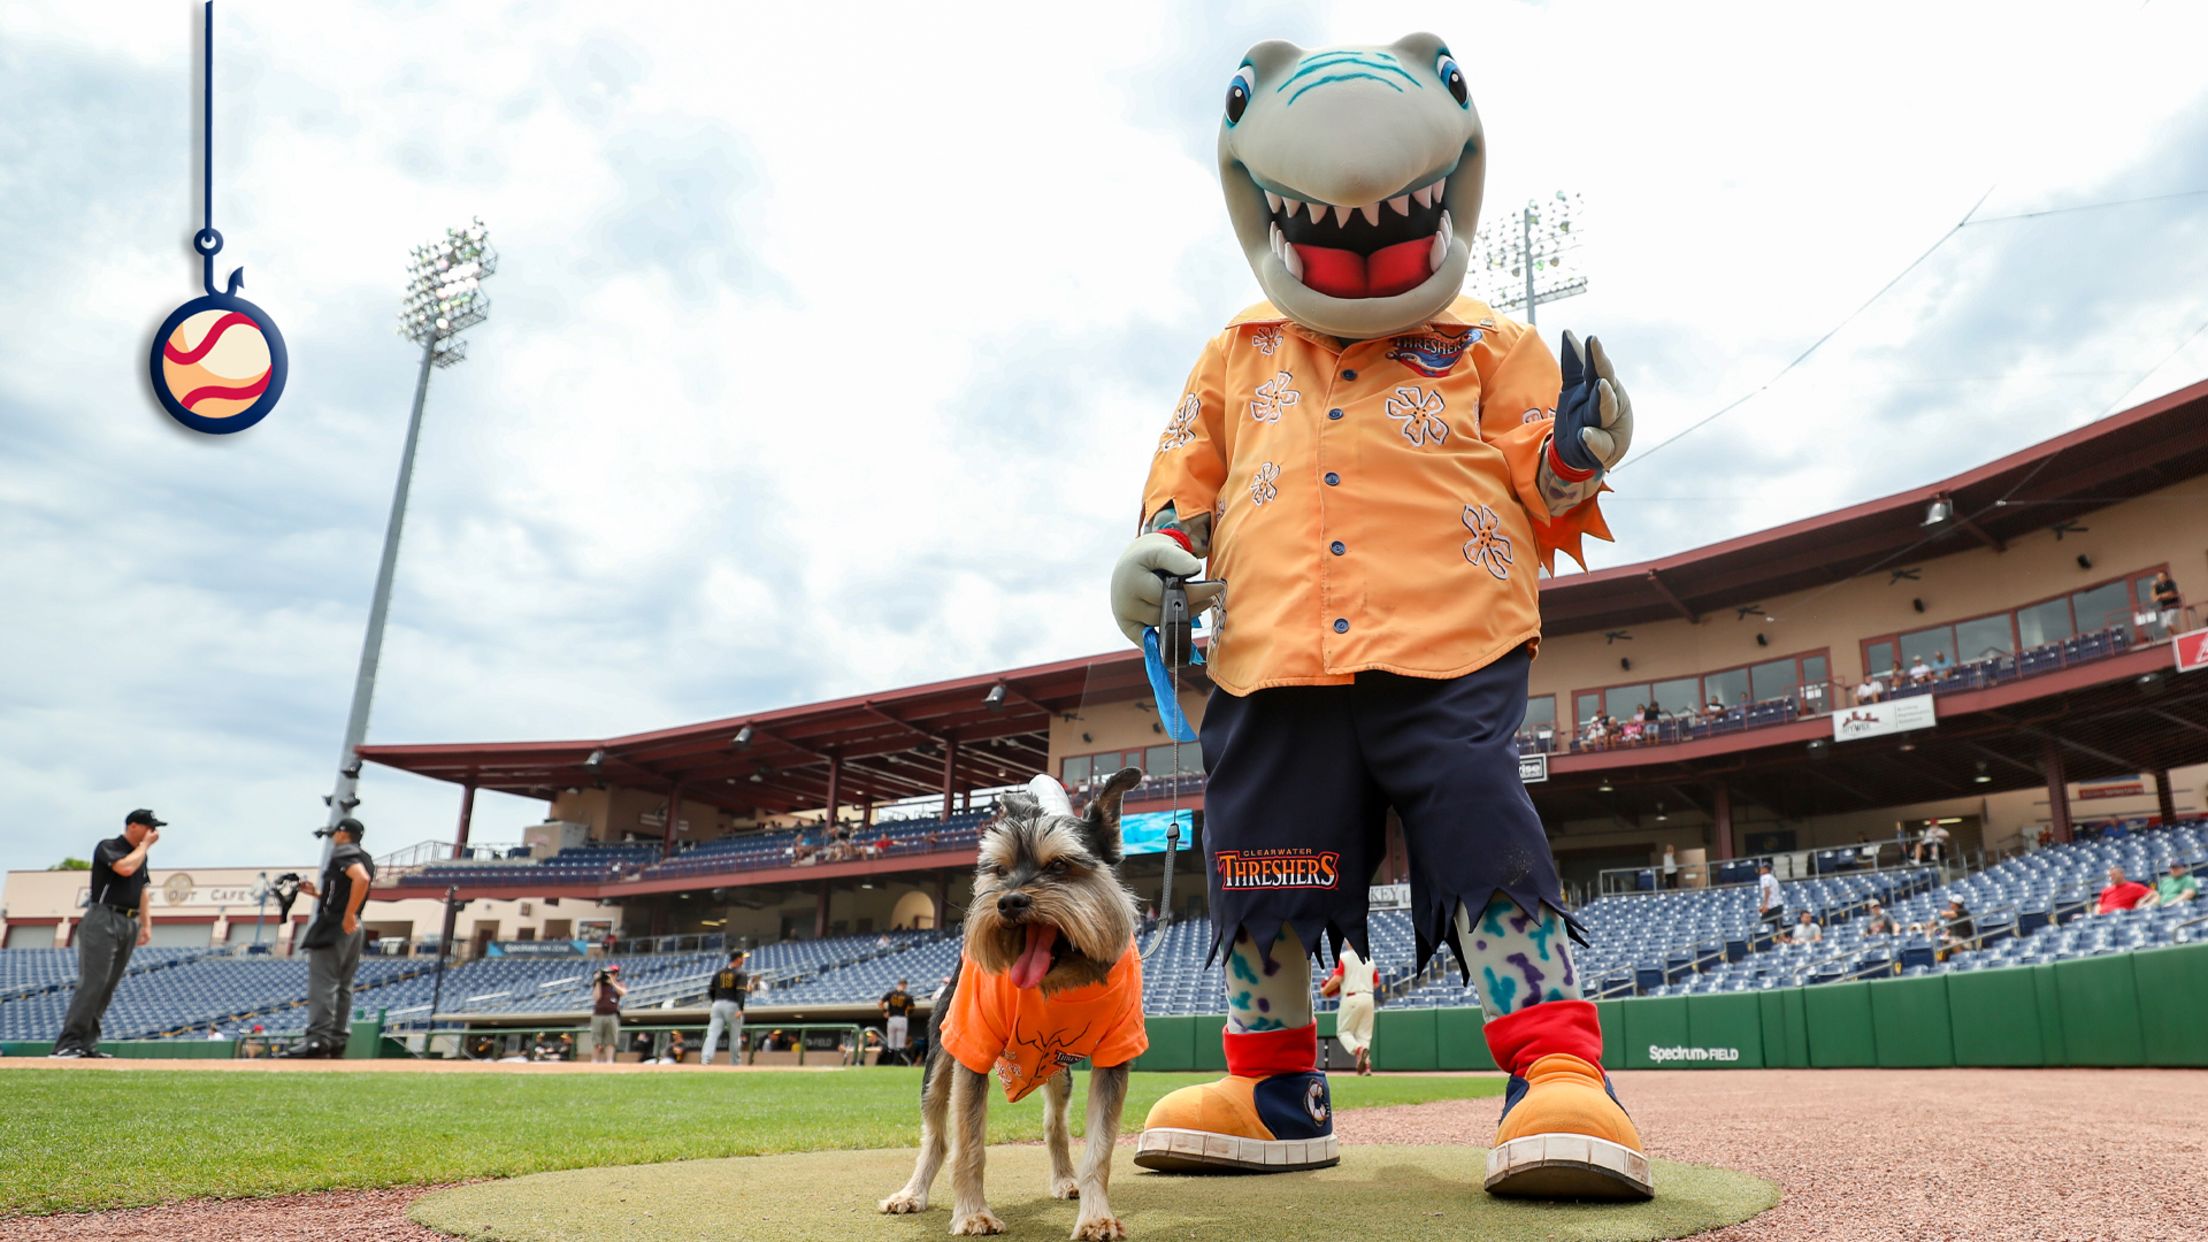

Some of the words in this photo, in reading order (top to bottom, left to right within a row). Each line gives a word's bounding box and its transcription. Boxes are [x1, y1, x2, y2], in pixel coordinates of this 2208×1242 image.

[1243, 848, 1312, 857] CLEARWATER
[1218, 854, 1336, 887] THRESHERS
[1649, 1045, 1703, 1063] Spectrum
[1709, 1048, 1739, 1060] FIELD
